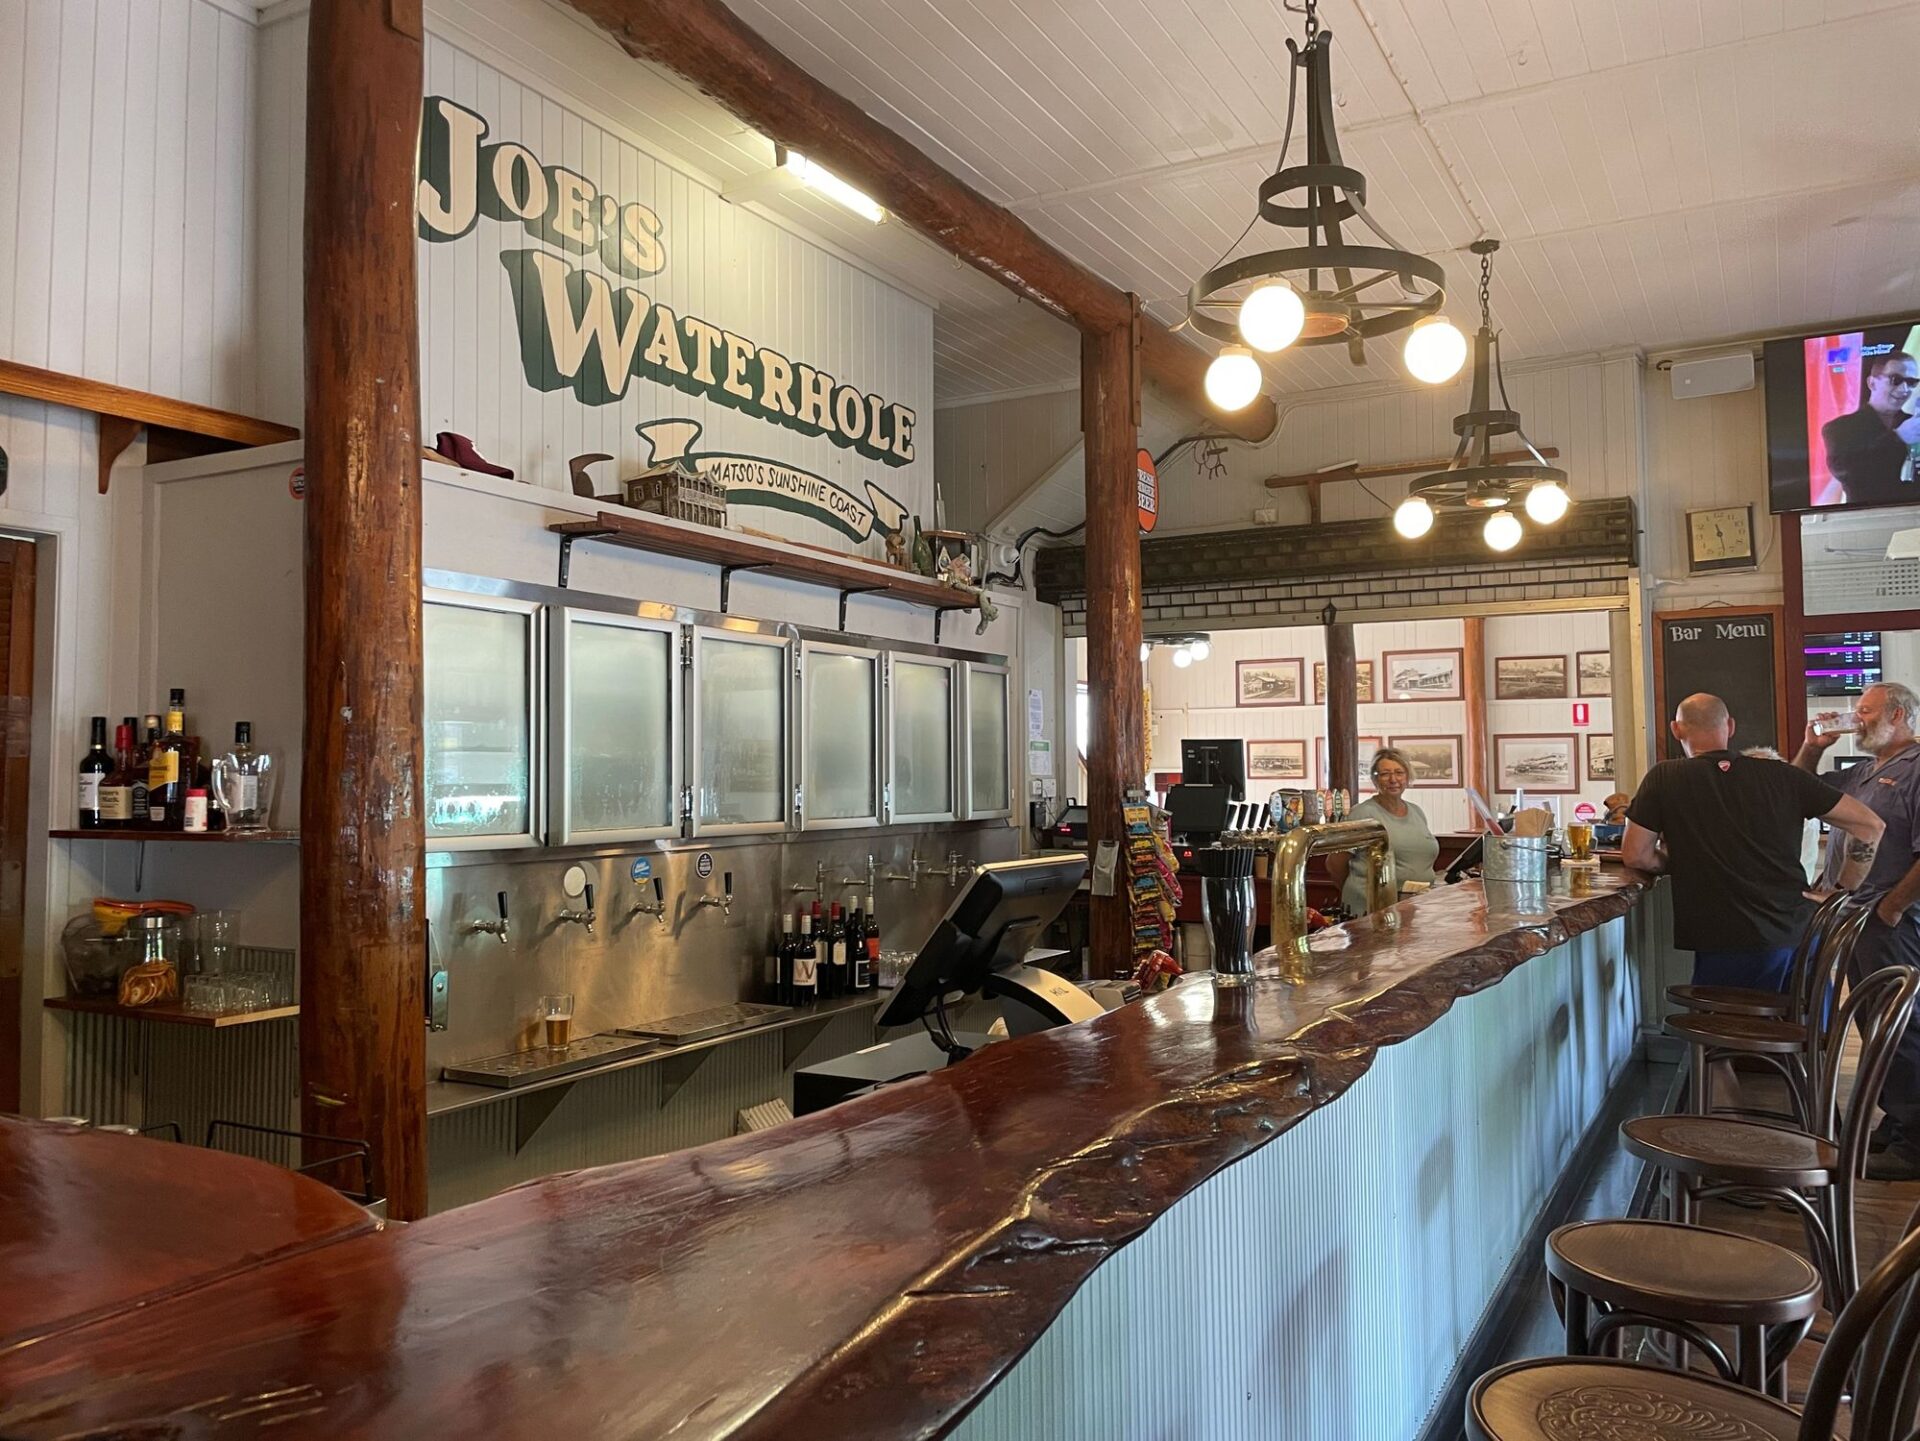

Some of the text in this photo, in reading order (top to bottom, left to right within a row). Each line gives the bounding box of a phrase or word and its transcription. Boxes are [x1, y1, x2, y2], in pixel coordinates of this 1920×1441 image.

[419, 96, 666, 277] JOE'S
[506, 250, 916, 467] WATERHOLE
[711, 461, 866, 527] MATSO'S SUNSHINE COAST
[1669, 623, 1767, 642] Bar Menu
